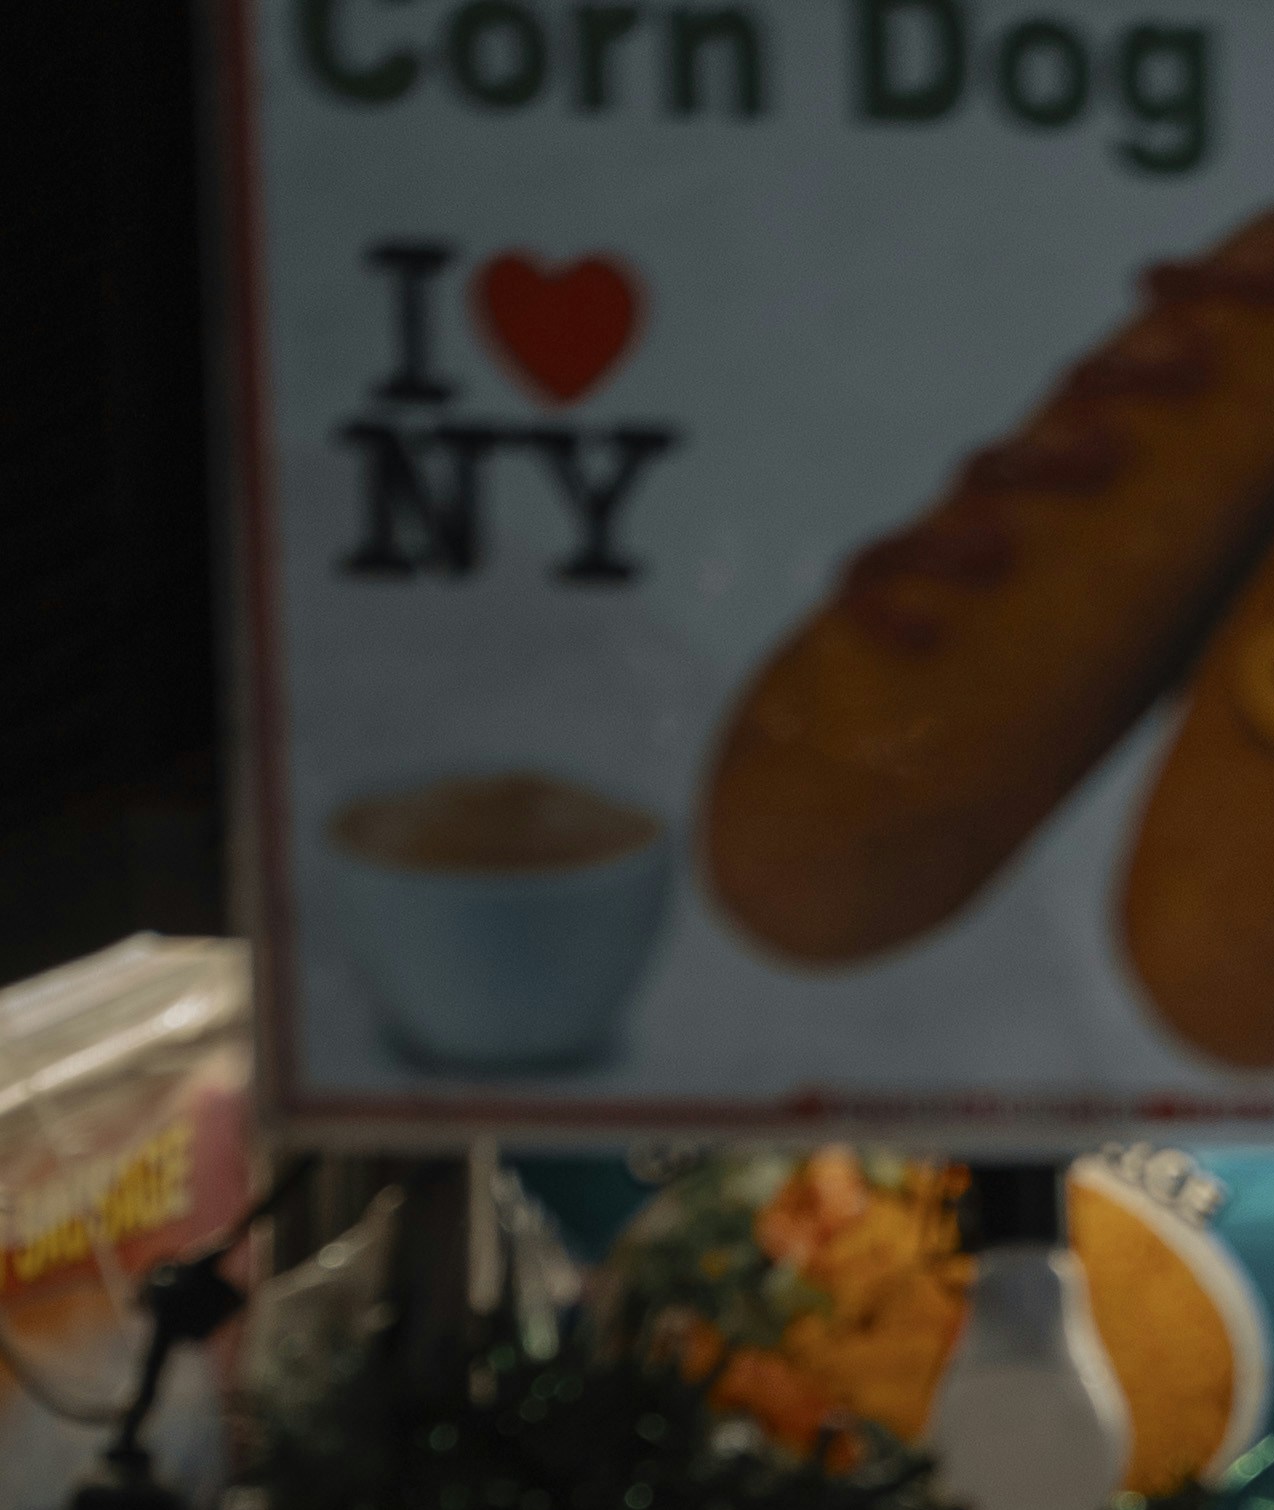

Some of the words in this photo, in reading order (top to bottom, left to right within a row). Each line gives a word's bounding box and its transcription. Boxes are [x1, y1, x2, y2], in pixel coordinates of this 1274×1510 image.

[299, 0, 769, 120] Corn
[856, 0, 1220, 176] Dog
[365, 243, 458, 404] I
[335, 420, 686, 584] NY
